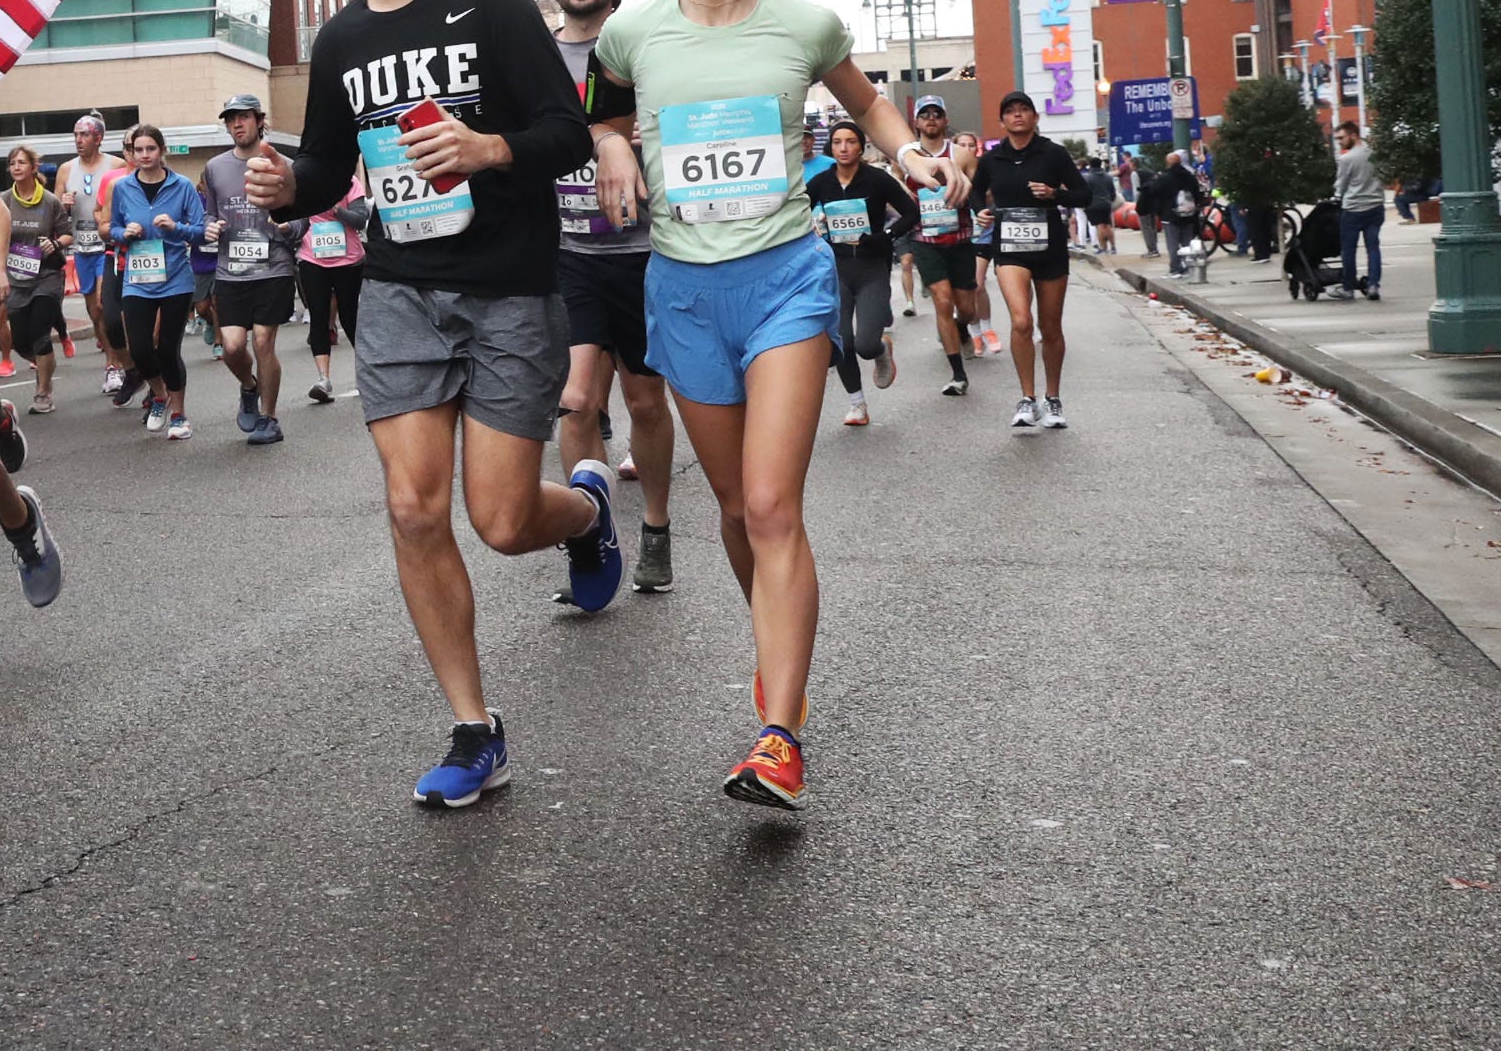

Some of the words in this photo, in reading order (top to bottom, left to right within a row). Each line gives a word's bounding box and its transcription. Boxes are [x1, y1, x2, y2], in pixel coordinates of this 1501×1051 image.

[342, 42, 480, 116] DUKE
[1124, 82, 1170, 100] REMEMB
[1124, 101, 1144, 114] The
[1147, 98, 1172, 112] Unbo
[682, 148, 766, 182] 6167
[382, 175, 433, 204] 627
[688, 188, 714, 198] HALF
[714, 182, 768, 196] MARATHON
[230, 196, 242, 204] ST.
[409, 200, 454, 215] MARATHON
[832, 216, 865, 229] 6566
[1008, 227, 1041, 238] 1250
[315, 236, 341, 246] 8105
[233, 246, 262, 257] 1054
[7, 256, 38, 271] 20505
[132, 258, 160, 268] 8103
